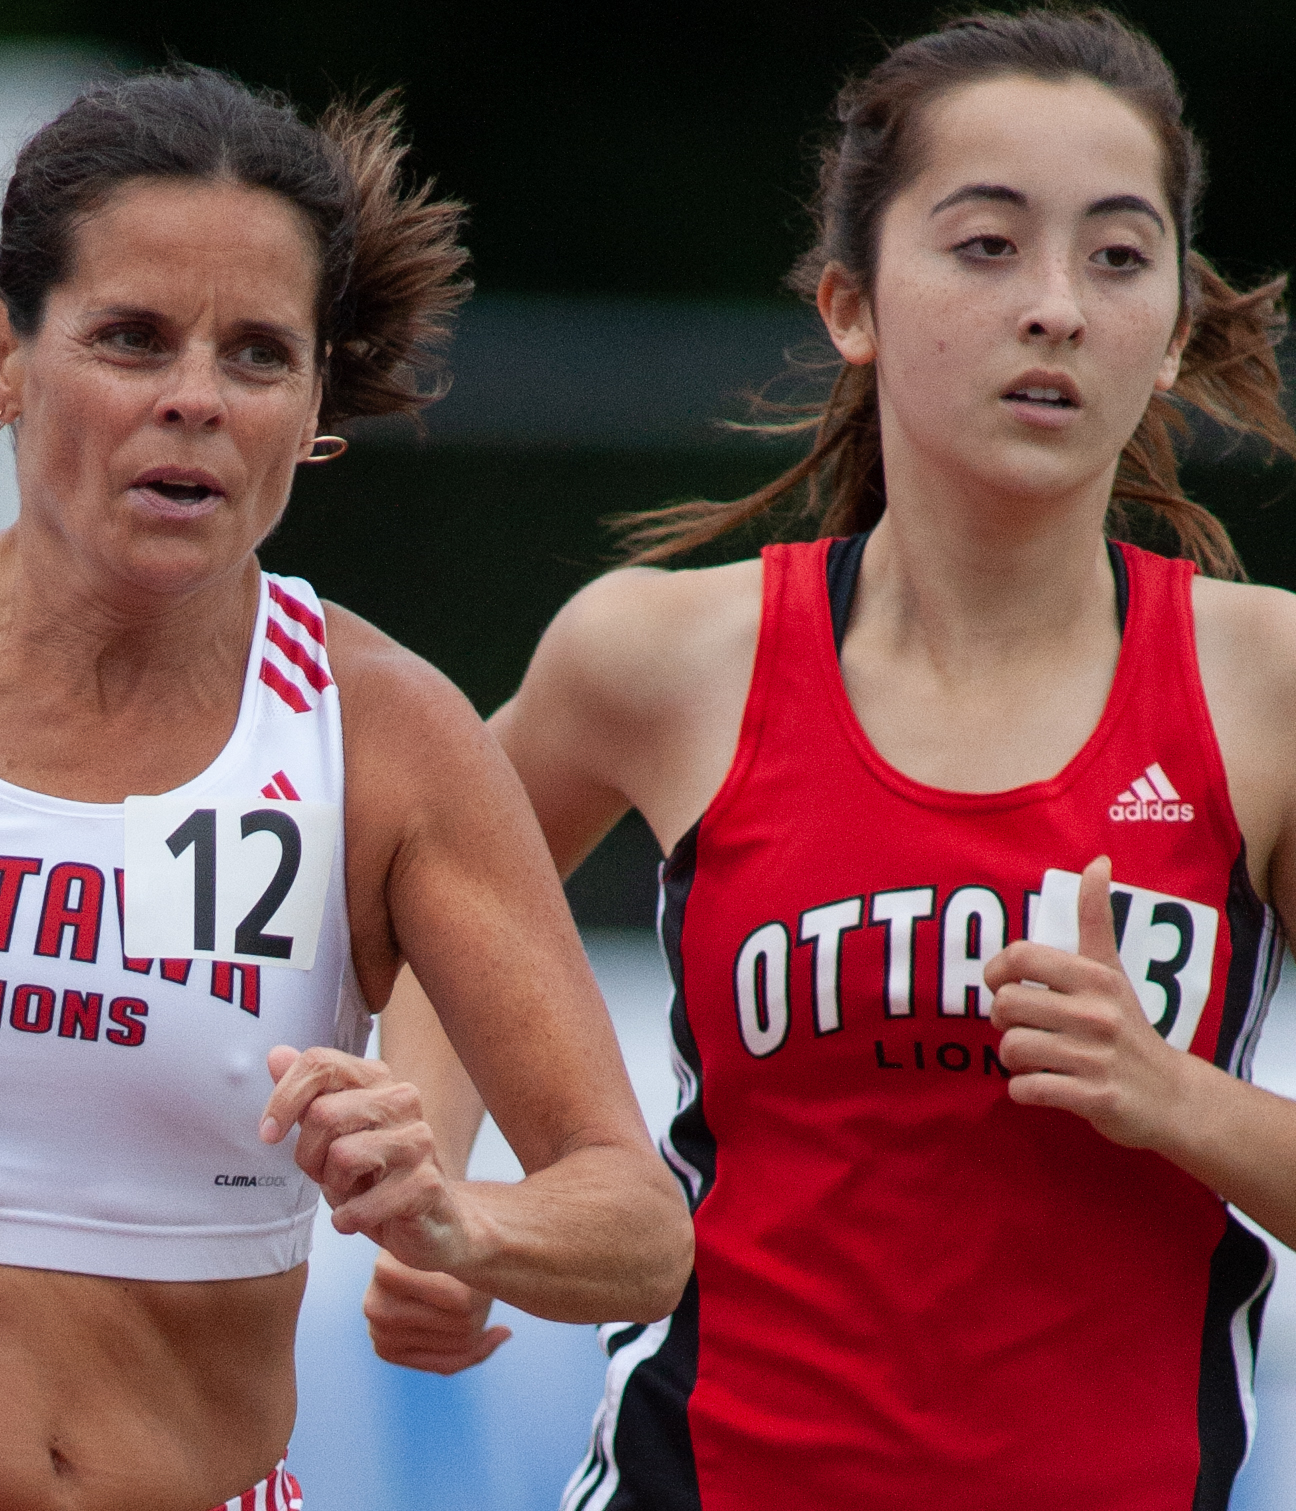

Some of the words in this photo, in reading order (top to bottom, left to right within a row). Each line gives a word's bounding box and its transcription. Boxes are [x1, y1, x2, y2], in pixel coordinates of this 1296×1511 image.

[165, 808, 302, 960] 12
[1109, 799, 1195, 822] adidas
[733, 884, 1042, 1060] OTTA
